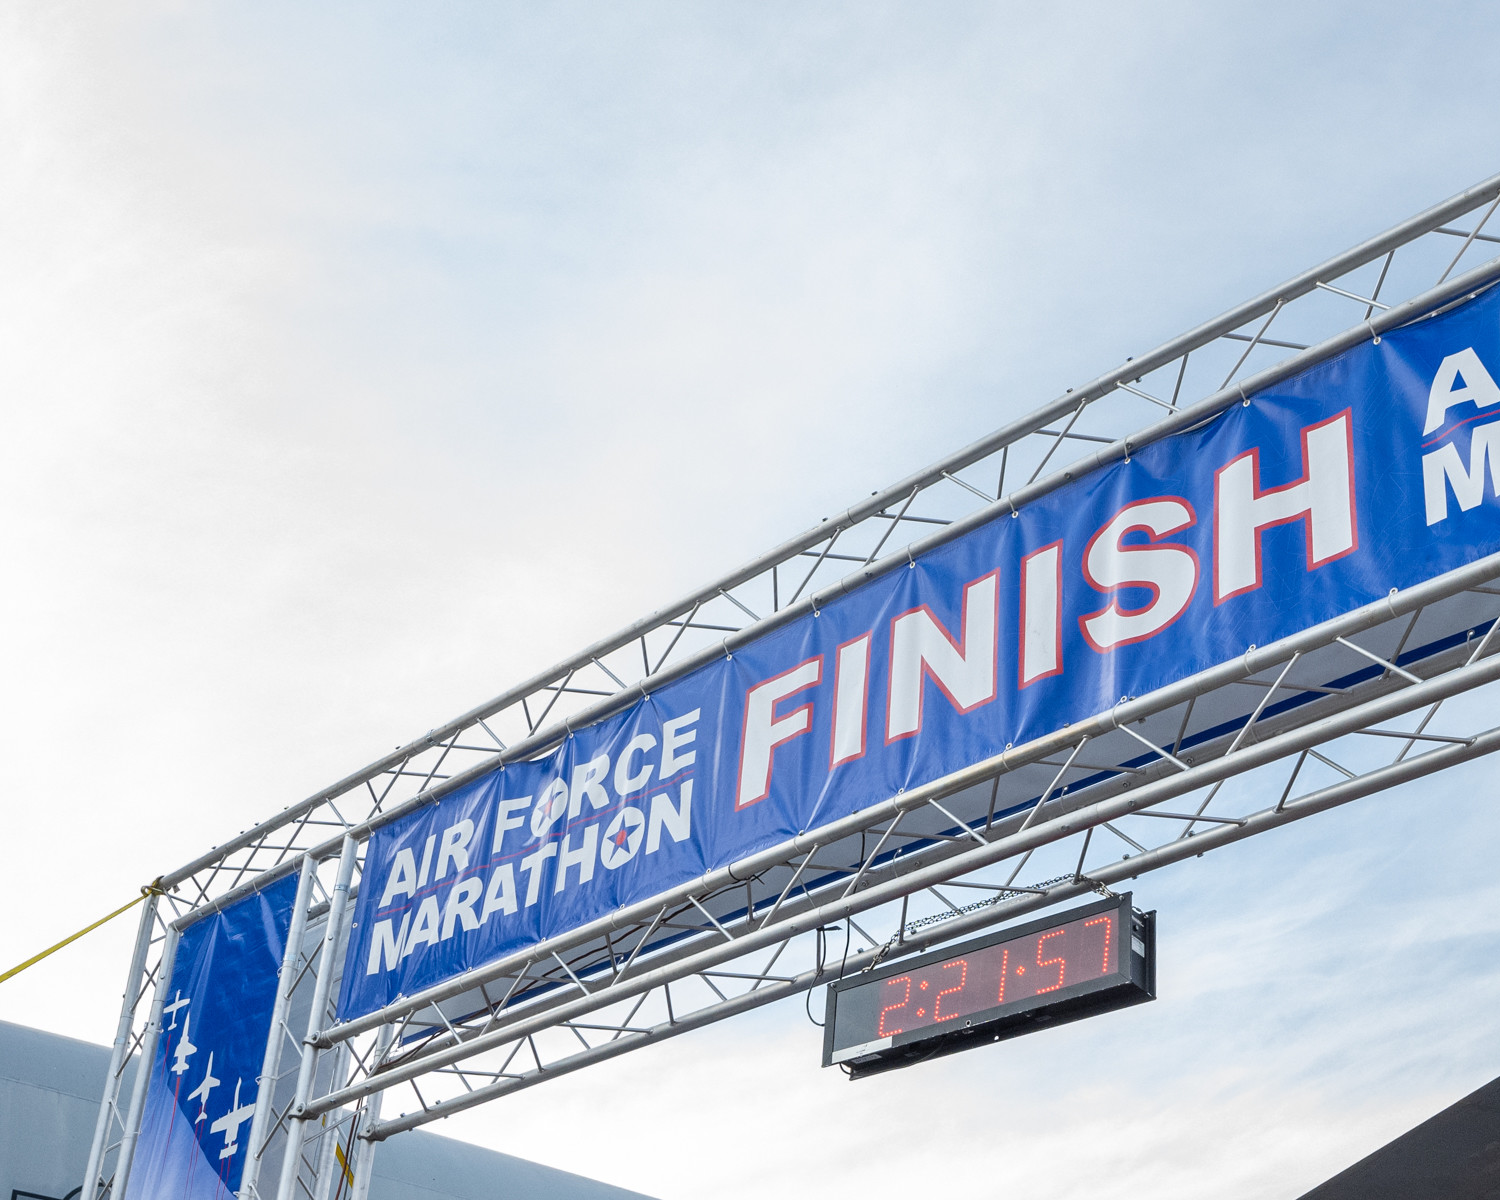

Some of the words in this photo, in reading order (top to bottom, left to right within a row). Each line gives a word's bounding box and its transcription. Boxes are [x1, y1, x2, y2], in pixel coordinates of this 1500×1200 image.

[735, 407, 1358, 811] FINISH
[367, 779, 693, 976] MARATHON
[378, 819, 473, 909] AIR
[492, 707, 701, 854] FORCE
